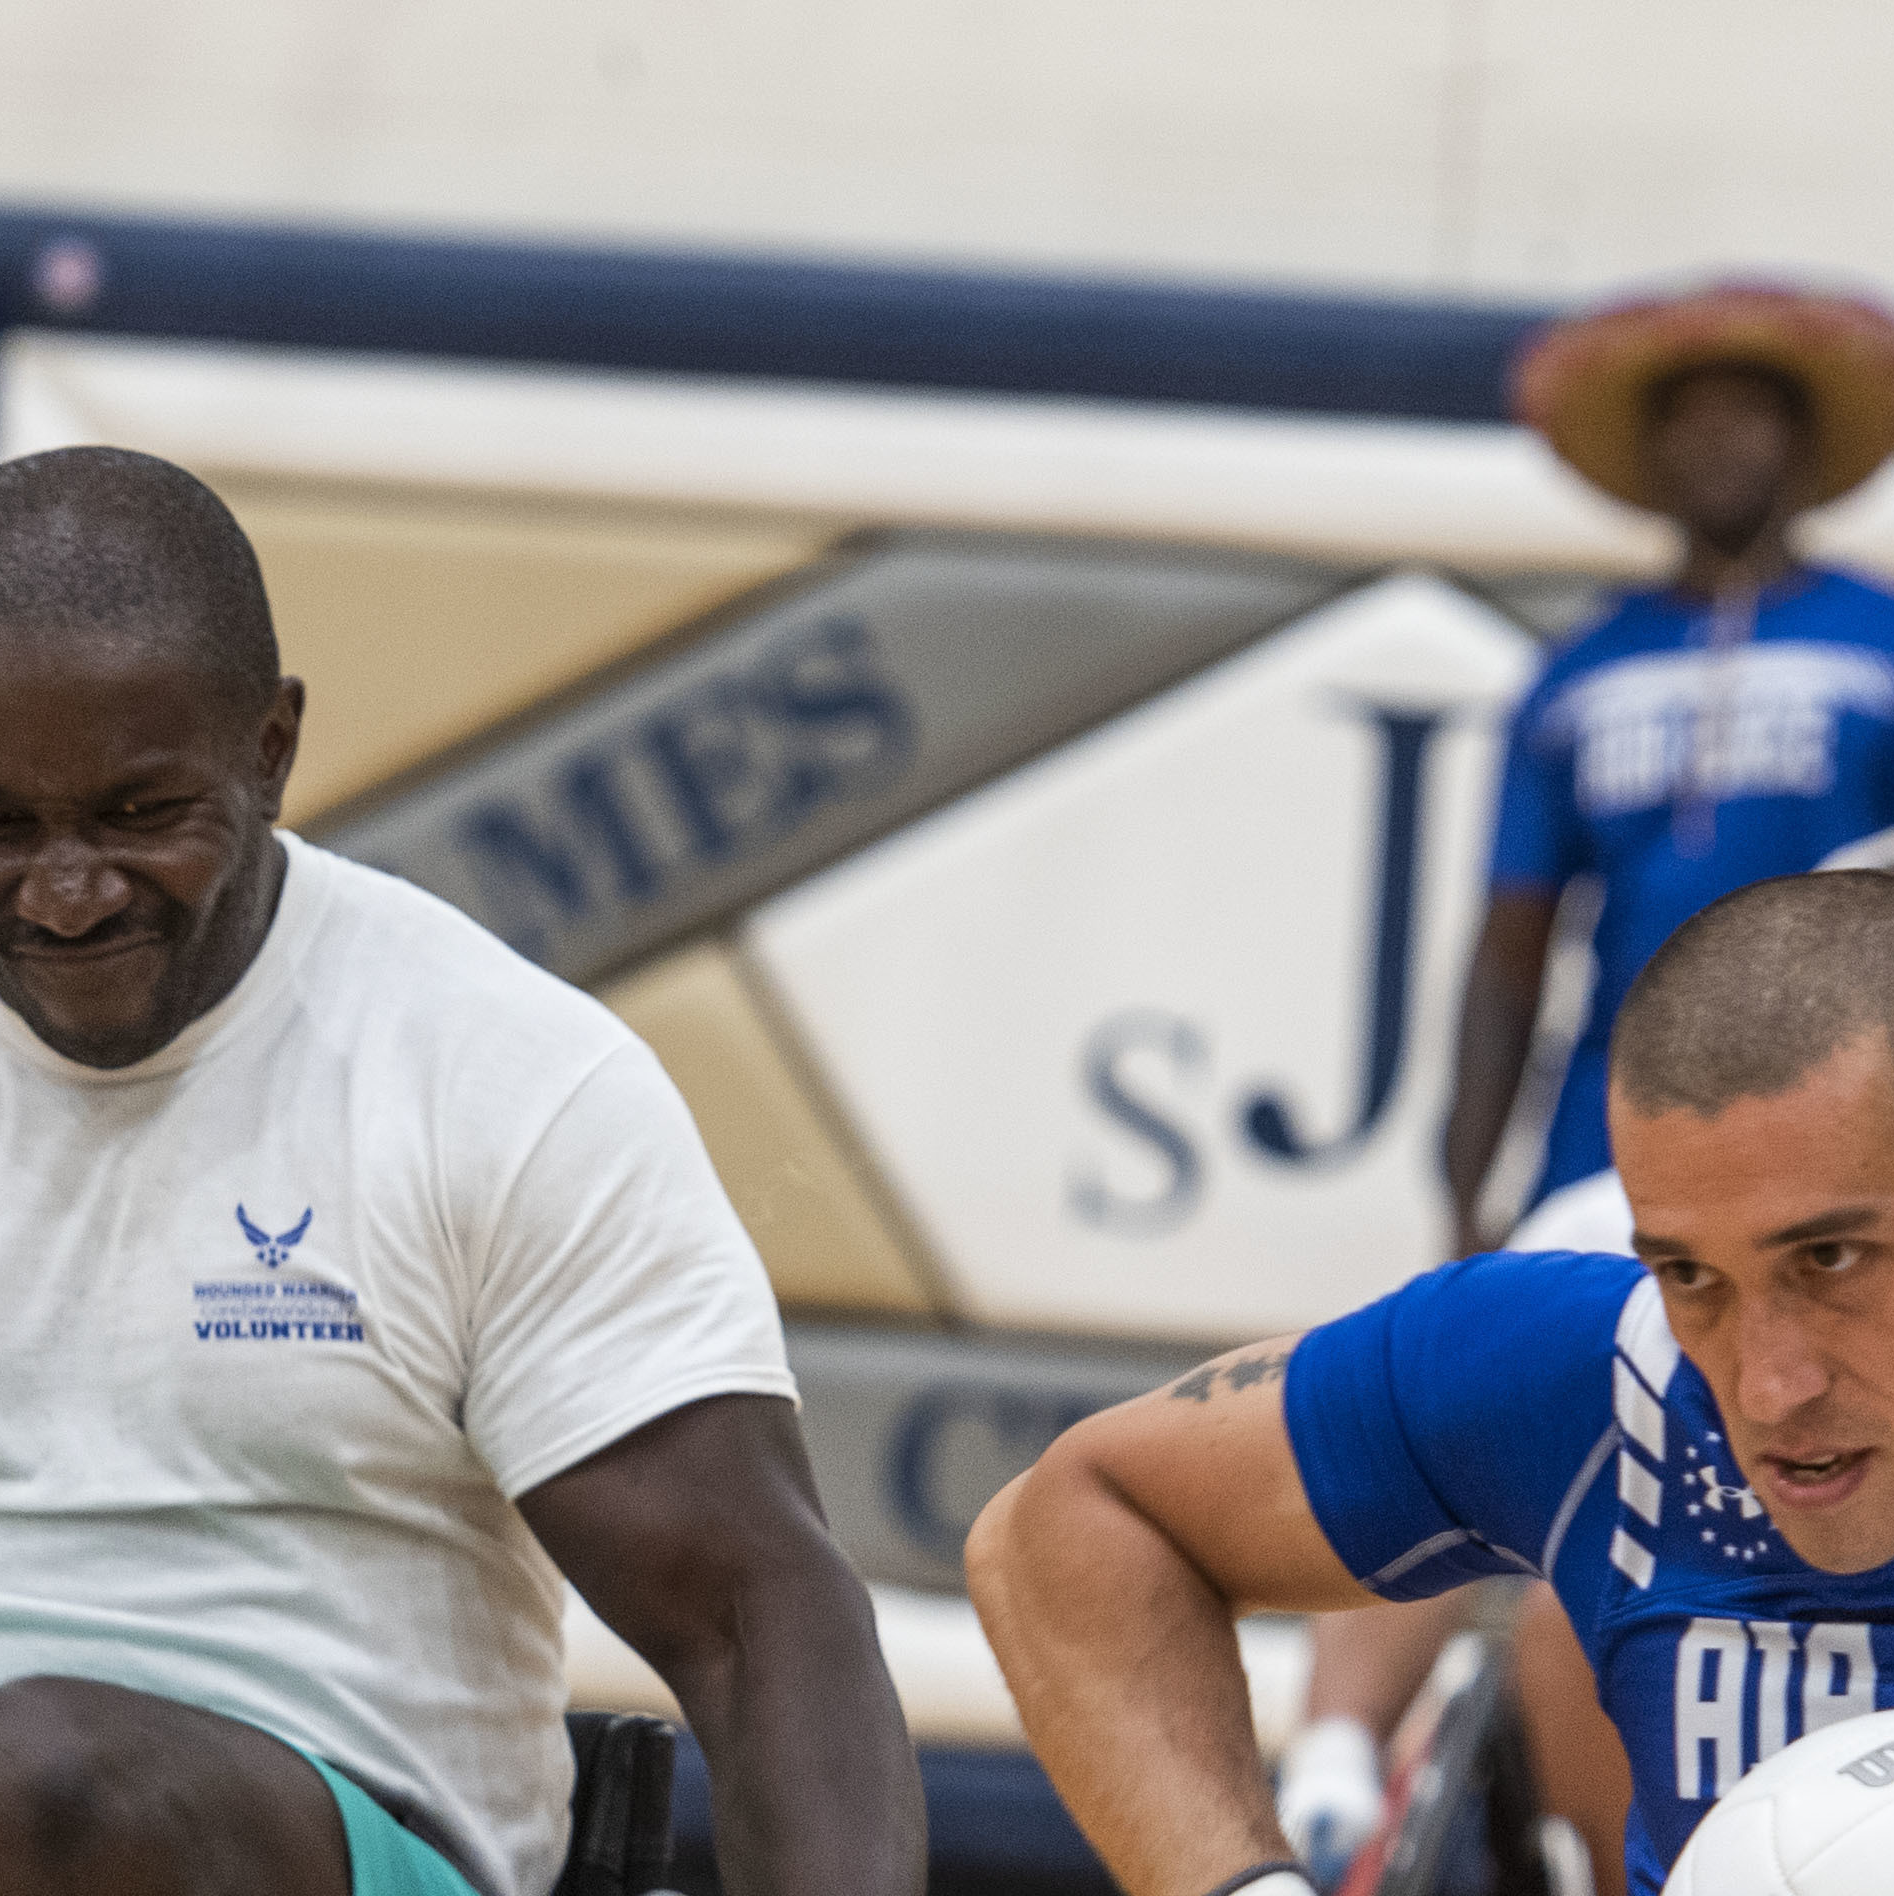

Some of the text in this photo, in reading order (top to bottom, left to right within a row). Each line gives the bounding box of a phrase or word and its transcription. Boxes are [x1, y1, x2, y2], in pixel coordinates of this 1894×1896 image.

[455, 612, 919, 960] MES
[194, 1321, 364, 1341] VOLUNTEER
[1677, 1617, 1879, 1800] AIR
